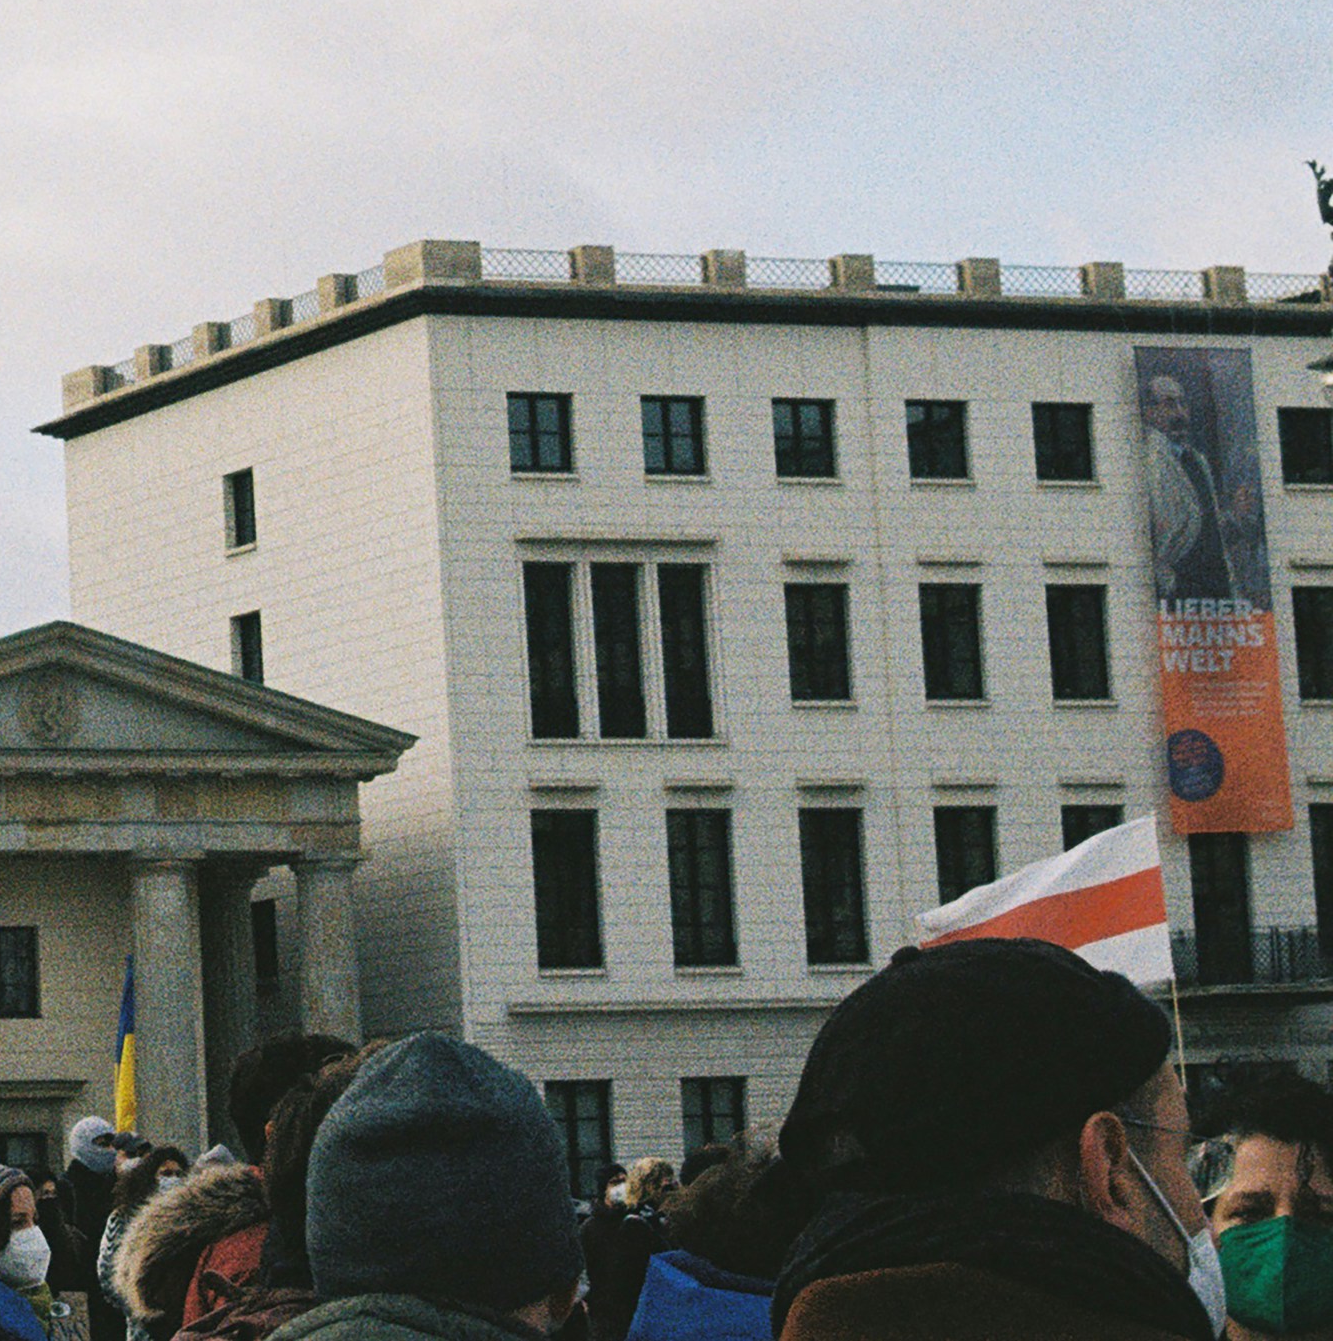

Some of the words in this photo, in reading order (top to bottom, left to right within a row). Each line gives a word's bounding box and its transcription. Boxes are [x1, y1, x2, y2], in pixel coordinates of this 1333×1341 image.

[1160, 599, 1264, 621] LIEBER-
[1162, 624, 1265, 646] MANNS
[1164, 649, 1234, 672] WELT
